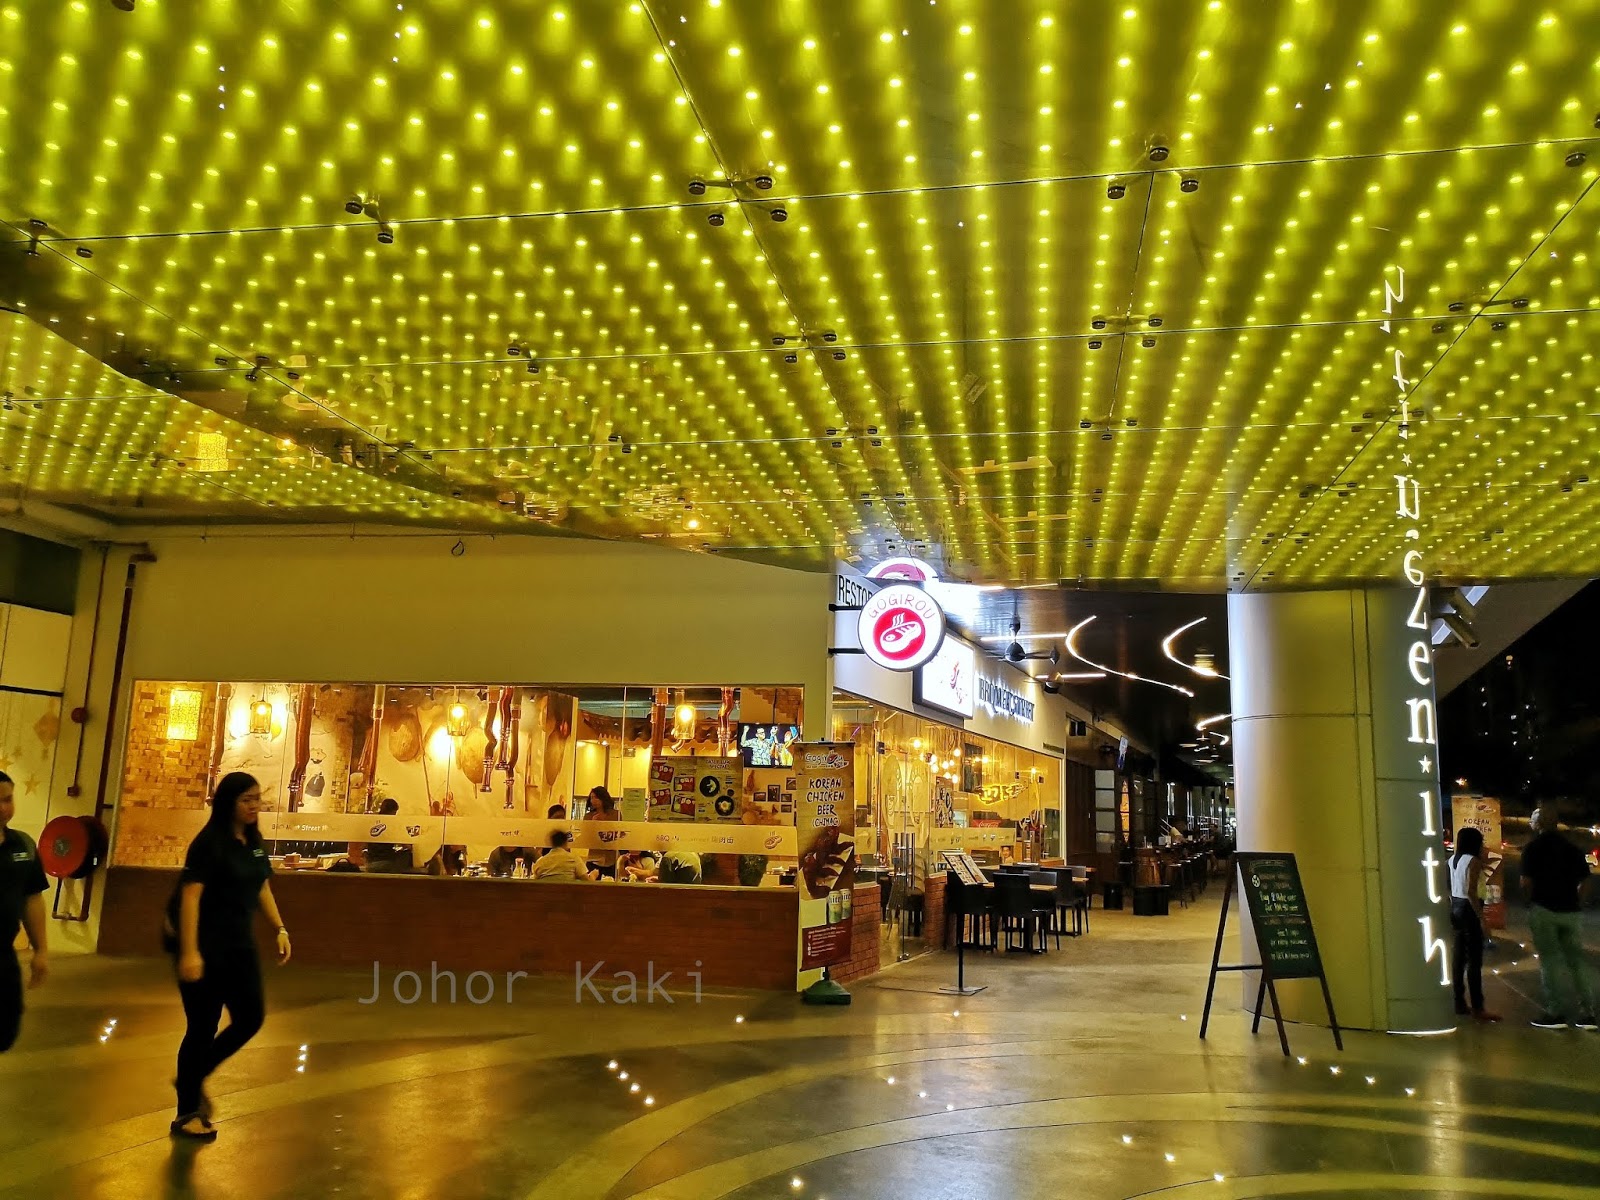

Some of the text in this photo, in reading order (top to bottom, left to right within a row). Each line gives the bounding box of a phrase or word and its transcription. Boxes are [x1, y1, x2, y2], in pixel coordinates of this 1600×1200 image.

[868, 593, 936, 620] GOGIROU
[809, 778, 842, 790] KOREAN
[806, 791, 845, 803] CHICKEN
[817, 803, 837, 816] BEER
[1463, 818, 1490, 826] KOREAN
